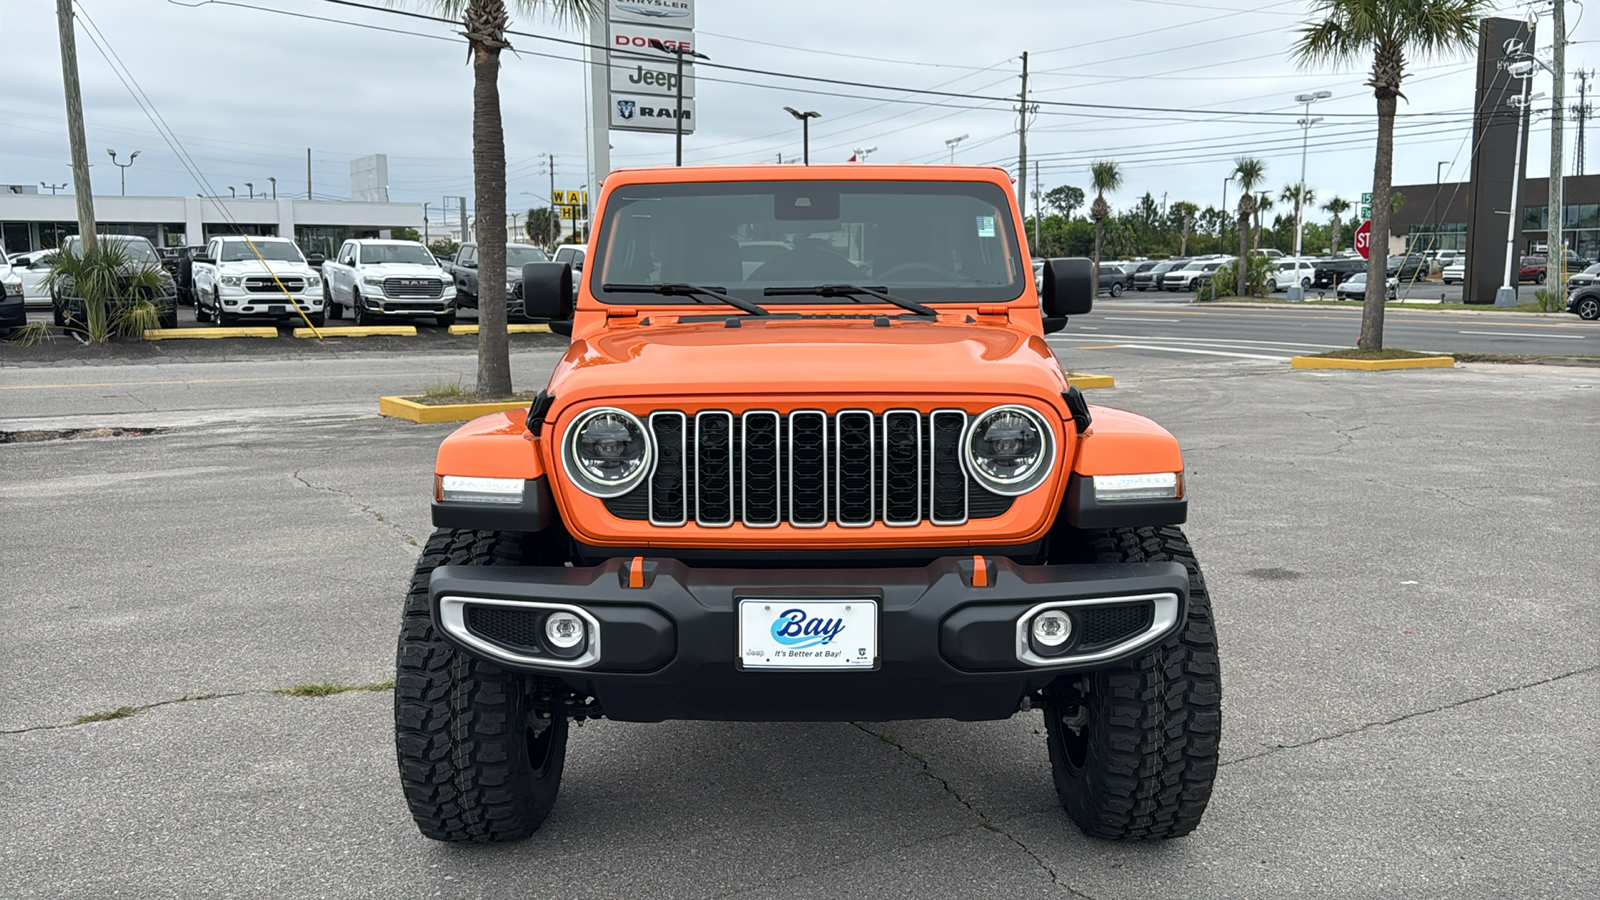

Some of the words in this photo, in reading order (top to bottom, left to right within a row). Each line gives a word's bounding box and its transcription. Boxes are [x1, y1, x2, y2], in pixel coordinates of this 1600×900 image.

[628, 65, 678, 91] Jeep
[639, 107, 691, 120] RAM
[1363, 194, 1372, 204] 15
[1361, 207, 1372, 218] Flo
[1357, 232, 1371, 248] ST
[776, 608, 846, 645] Bay
[824, 650, 842, 658] Bay!
